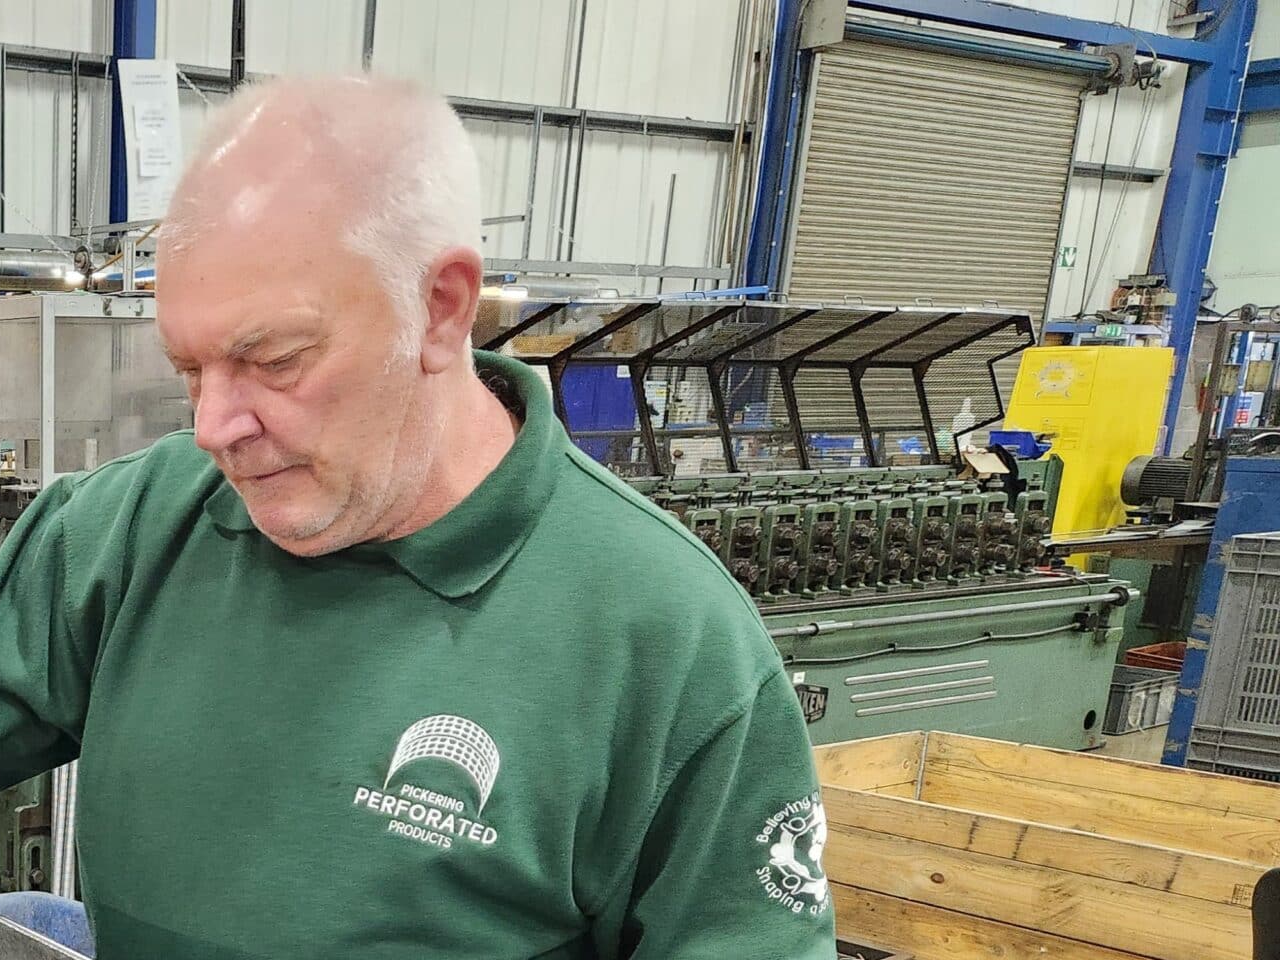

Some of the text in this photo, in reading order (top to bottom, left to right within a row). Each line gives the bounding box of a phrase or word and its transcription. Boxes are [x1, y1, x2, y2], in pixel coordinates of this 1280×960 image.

[353, 786, 498, 845] PERFORATED
[400, 783, 464, 813] PICKERING
[755, 794, 812, 843] Believing
[388, 819, 453, 849] PRODUCTS
[755, 865, 805, 914] Shaping
